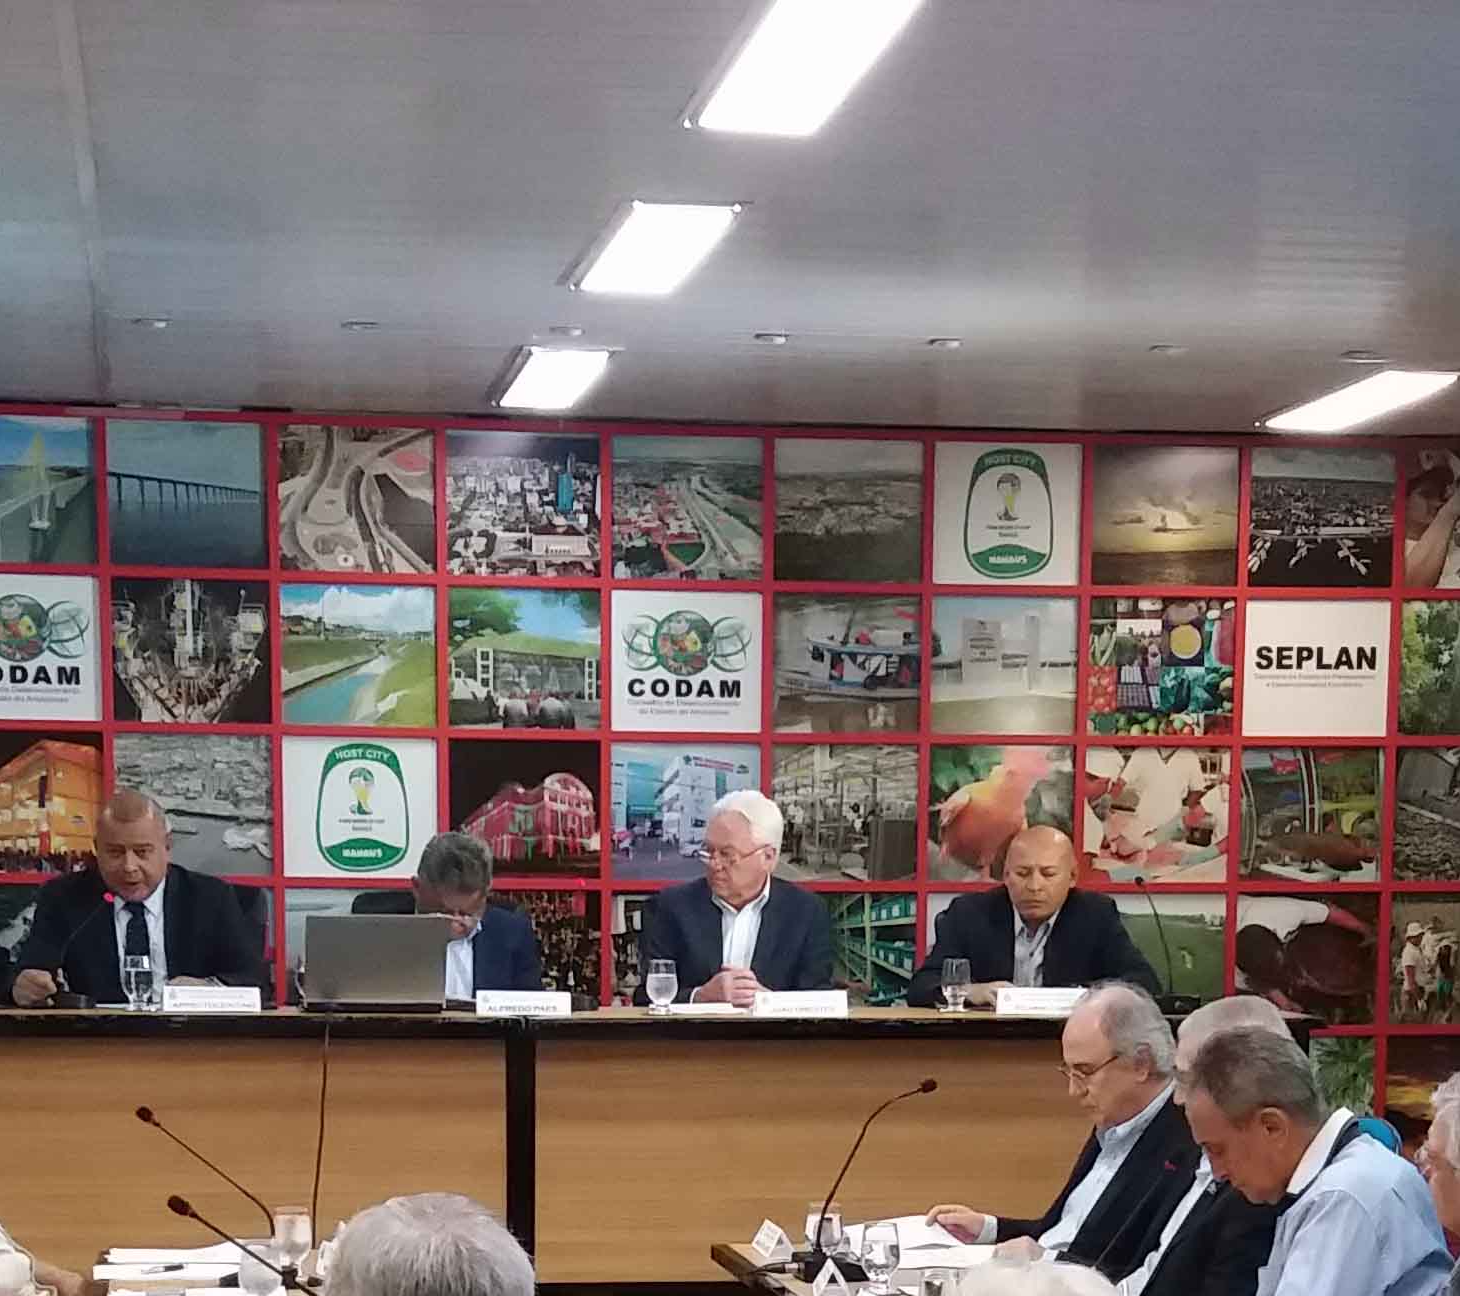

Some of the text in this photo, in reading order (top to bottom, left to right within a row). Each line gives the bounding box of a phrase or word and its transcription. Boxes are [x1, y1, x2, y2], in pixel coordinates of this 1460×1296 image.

[1254, 646, 1377, 671] SEPLAN
[627, 678, 741, 698] CODAM
[335, 748, 391, 760] HOST CITY
